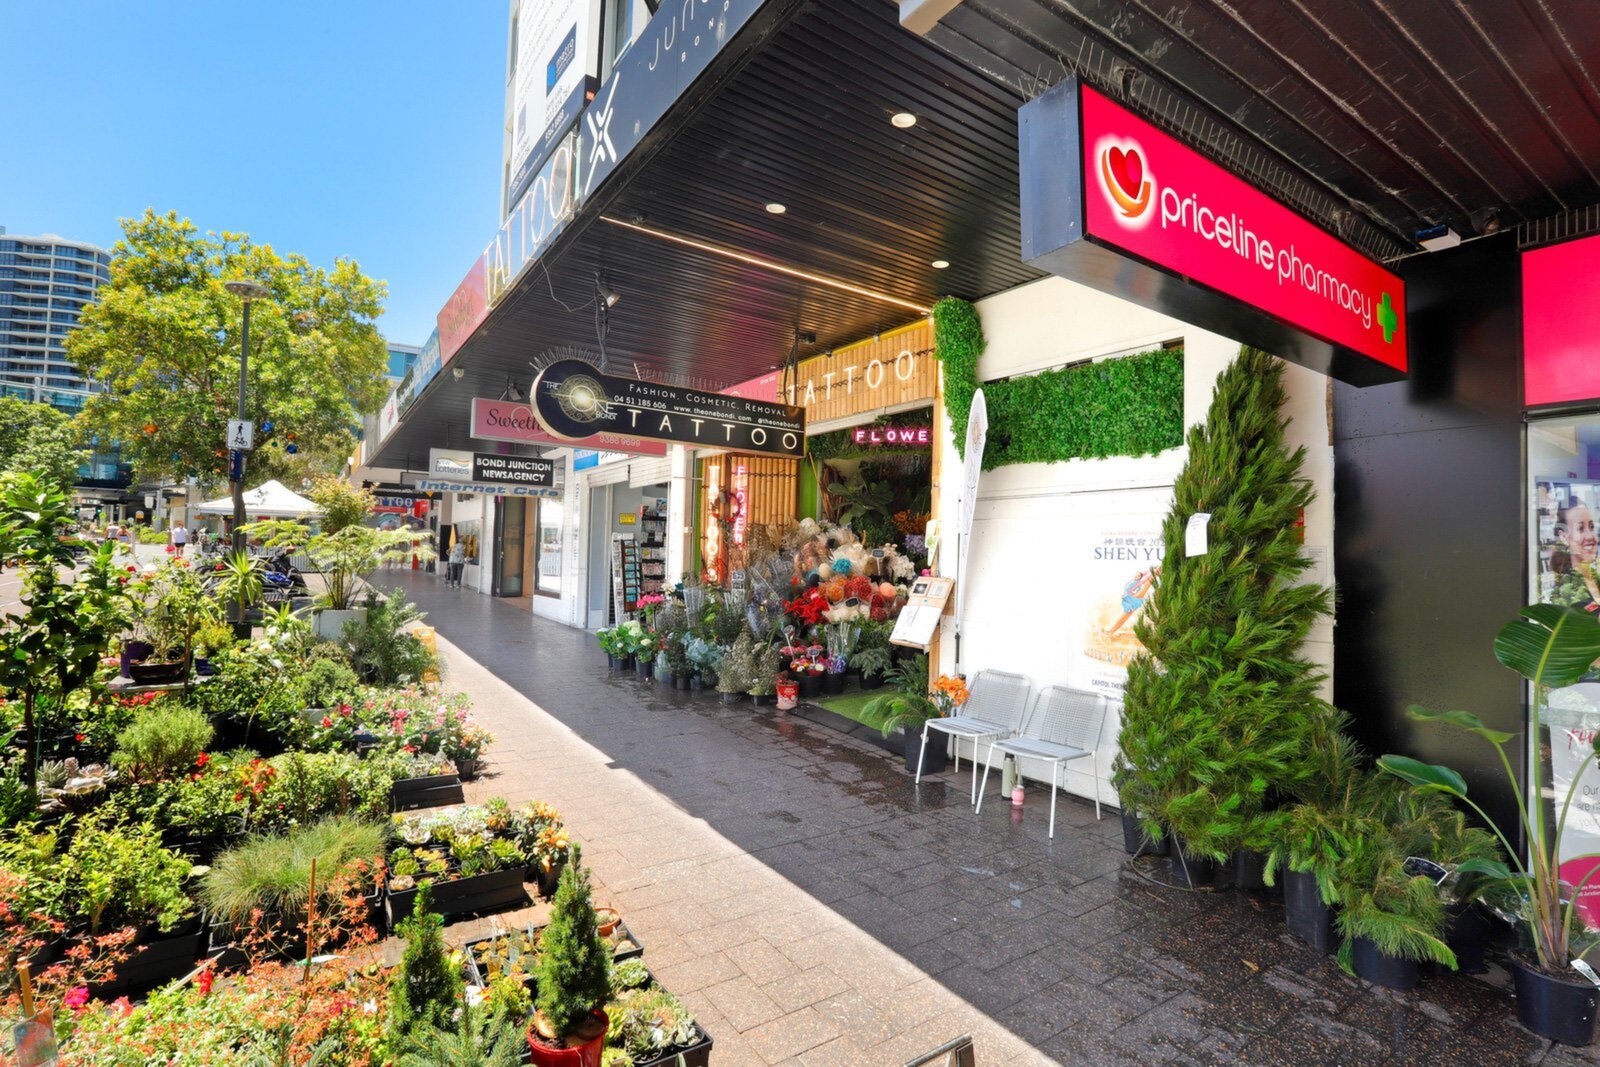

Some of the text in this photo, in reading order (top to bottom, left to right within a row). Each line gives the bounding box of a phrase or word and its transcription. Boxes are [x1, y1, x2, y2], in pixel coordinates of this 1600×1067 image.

[483, 146, 570, 301] TATTOO
[1161, 187, 1371, 329] priceline pharmacy
[788, 350, 914, 406] TATTOO
[638, 399, 651, 407] 185
[653, 401, 667, 409] 606
[746, 403, 786, 417] REMOVAL
[486, 409, 543, 432] Sweeth
[627, 409, 797, 450] TATTOO
[476, 458, 552, 471] BONDI JUNCTION
[483, 470, 545, 482] NEWSAGENCY
[420, 480, 506, 494] Internet
[513, 487, 559, 497] Cafe
[1094, 547, 1137, 560] SHEN
